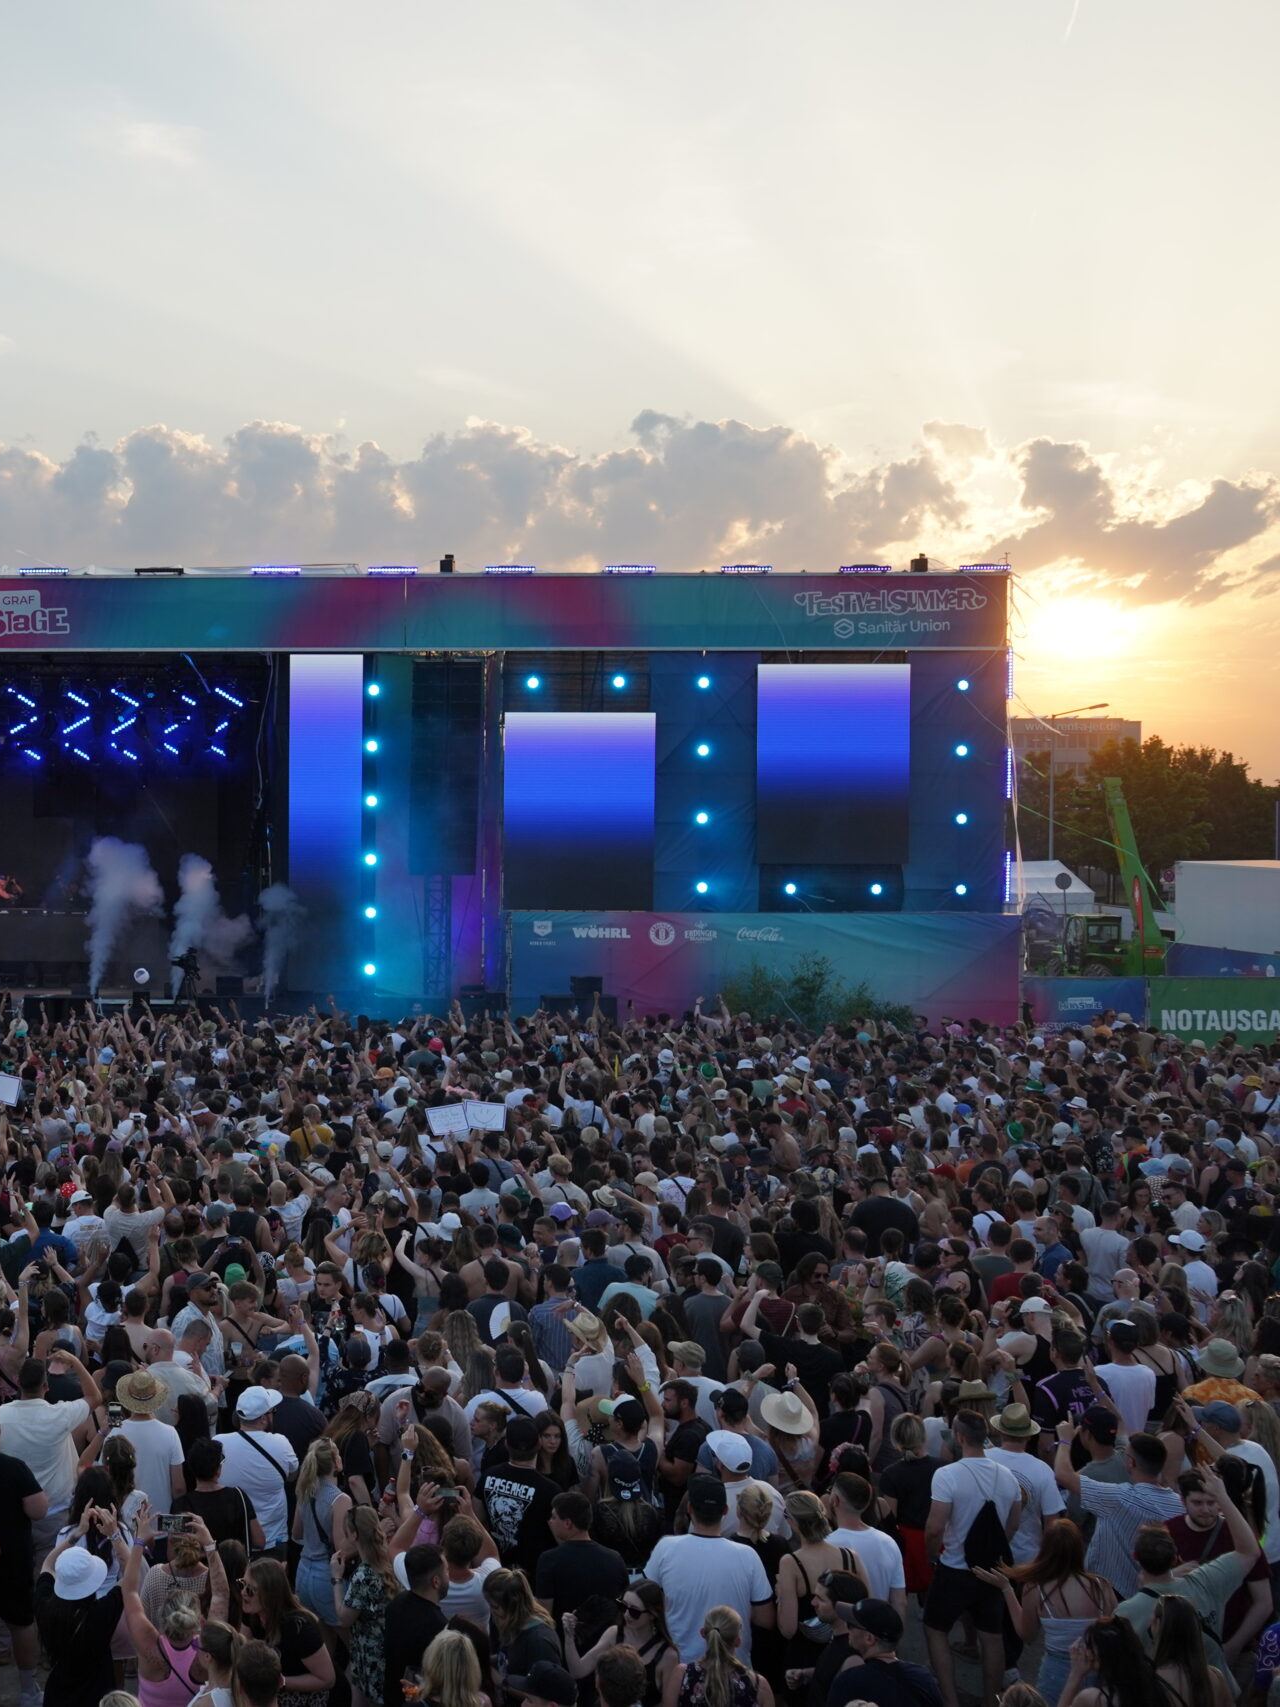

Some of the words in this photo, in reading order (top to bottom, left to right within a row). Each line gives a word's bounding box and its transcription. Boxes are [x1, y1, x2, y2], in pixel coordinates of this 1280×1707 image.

[2, 595, 35, 606] GRAF
[857, 620, 908, 634] Sanitär
[909, 619, 951, 633] Union
[572, 924, 631, 939] WÖHRL
[1161, 1009, 1280, 1031] NOTAUSGA
[484, 1475, 536, 1501] BERSERKER
